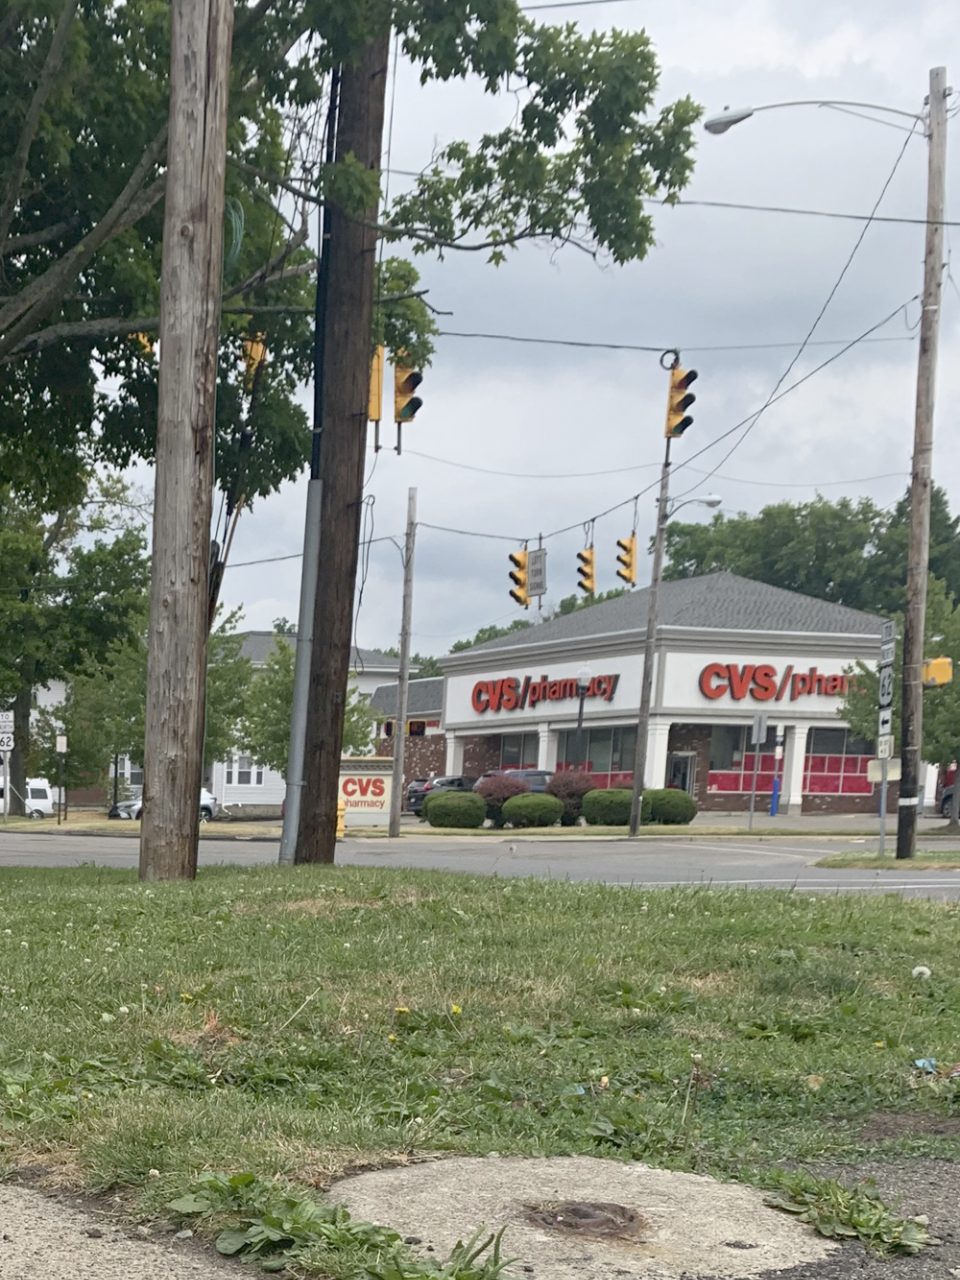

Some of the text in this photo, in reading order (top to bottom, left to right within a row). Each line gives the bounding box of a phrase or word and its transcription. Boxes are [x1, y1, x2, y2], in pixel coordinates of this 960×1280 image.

[699, 663, 860, 701] CVS/phar
[881, 673, 892, 698] 62
[0, 736, 12, 747] 62
[342, 777, 385, 797] CVS
